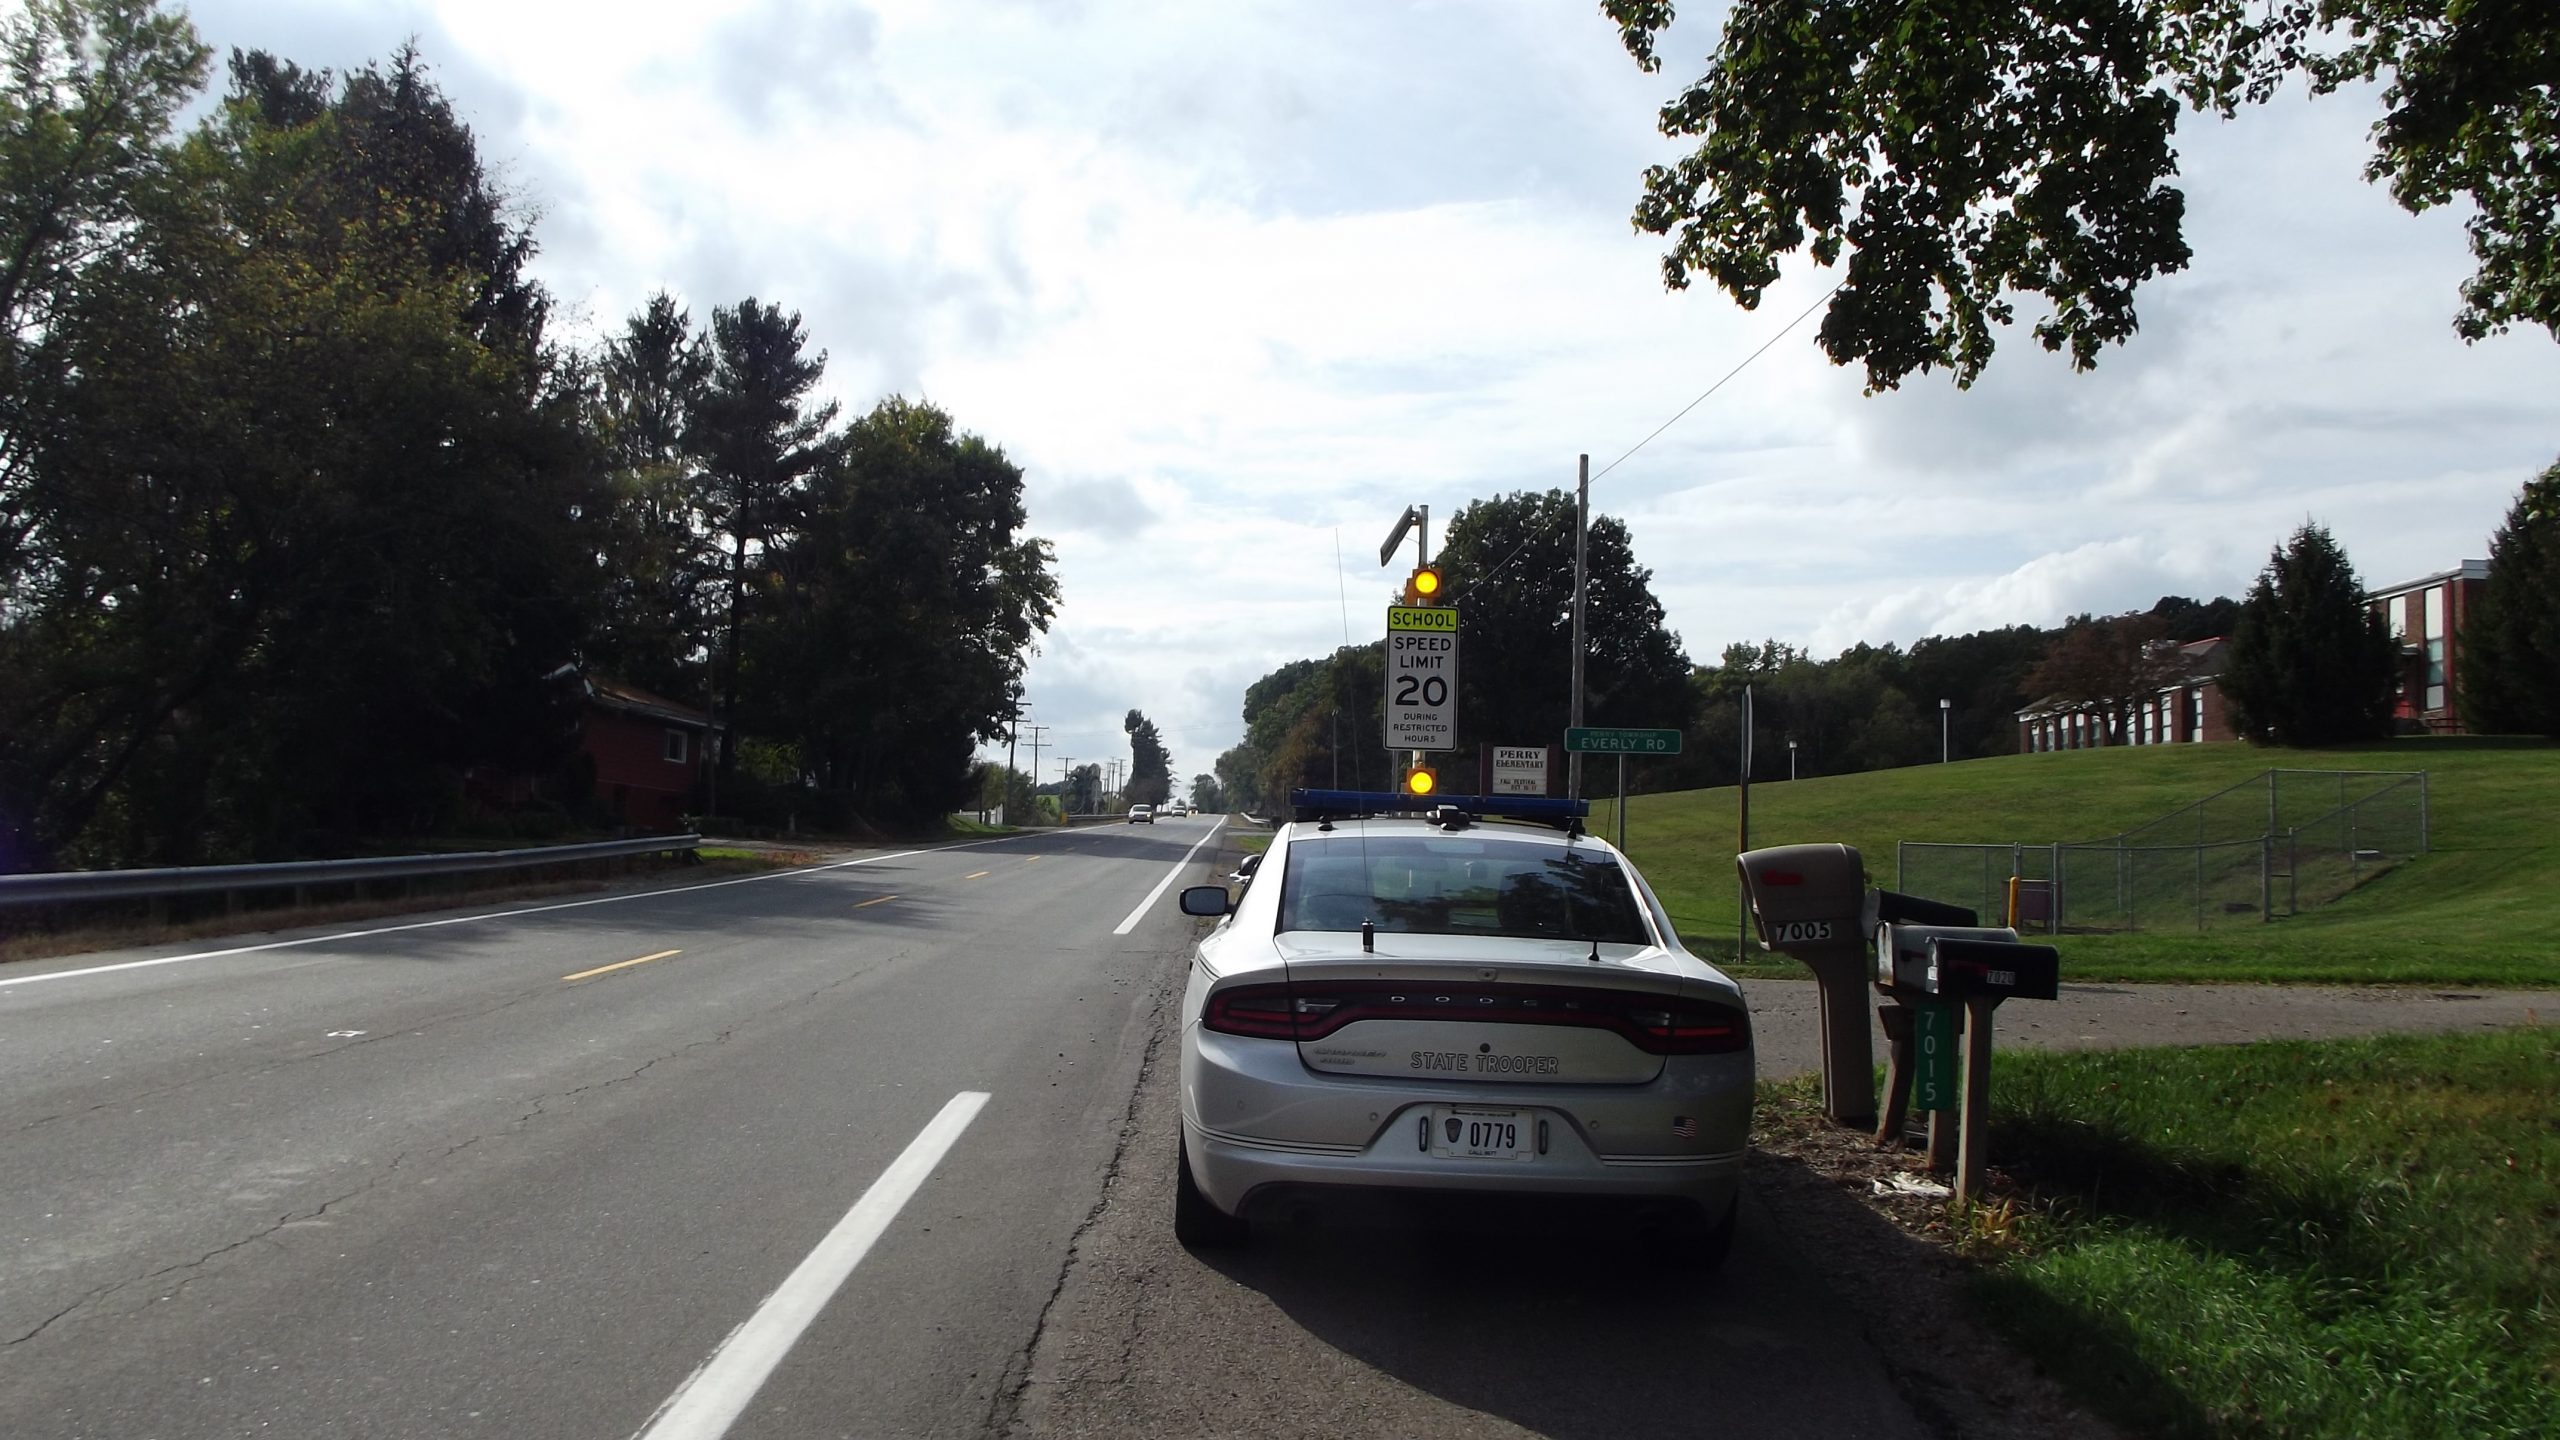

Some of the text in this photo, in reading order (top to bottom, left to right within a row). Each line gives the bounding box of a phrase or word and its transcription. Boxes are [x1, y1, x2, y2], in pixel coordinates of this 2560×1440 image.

[1392, 612, 1454, 627] SCHOOL
[1394, 636, 1451, 651] SPEED
[1400, 655, 1444, 669] LIMIT
[1395, 675, 1448, 707] 20
[1403, 713, 1438, 721] DURING
[1393, 724, 1448, 732] RESTRICTED
[1404, 735, 1436, 743] HOURS
[1581, 738, 1666, 750] EVERLY RD
[1500, 750, 1540, 759] PERRY
[1496, 760, 1544, 768] ELEMENTARY
[1777, 922, 1830, 941] 7005
[1410, 1051, 1559, 1074] STATE TROOPER
[1924, 1011, 1937, 1102] 7015
[1470, 1122, 1516, 1149] 0779
